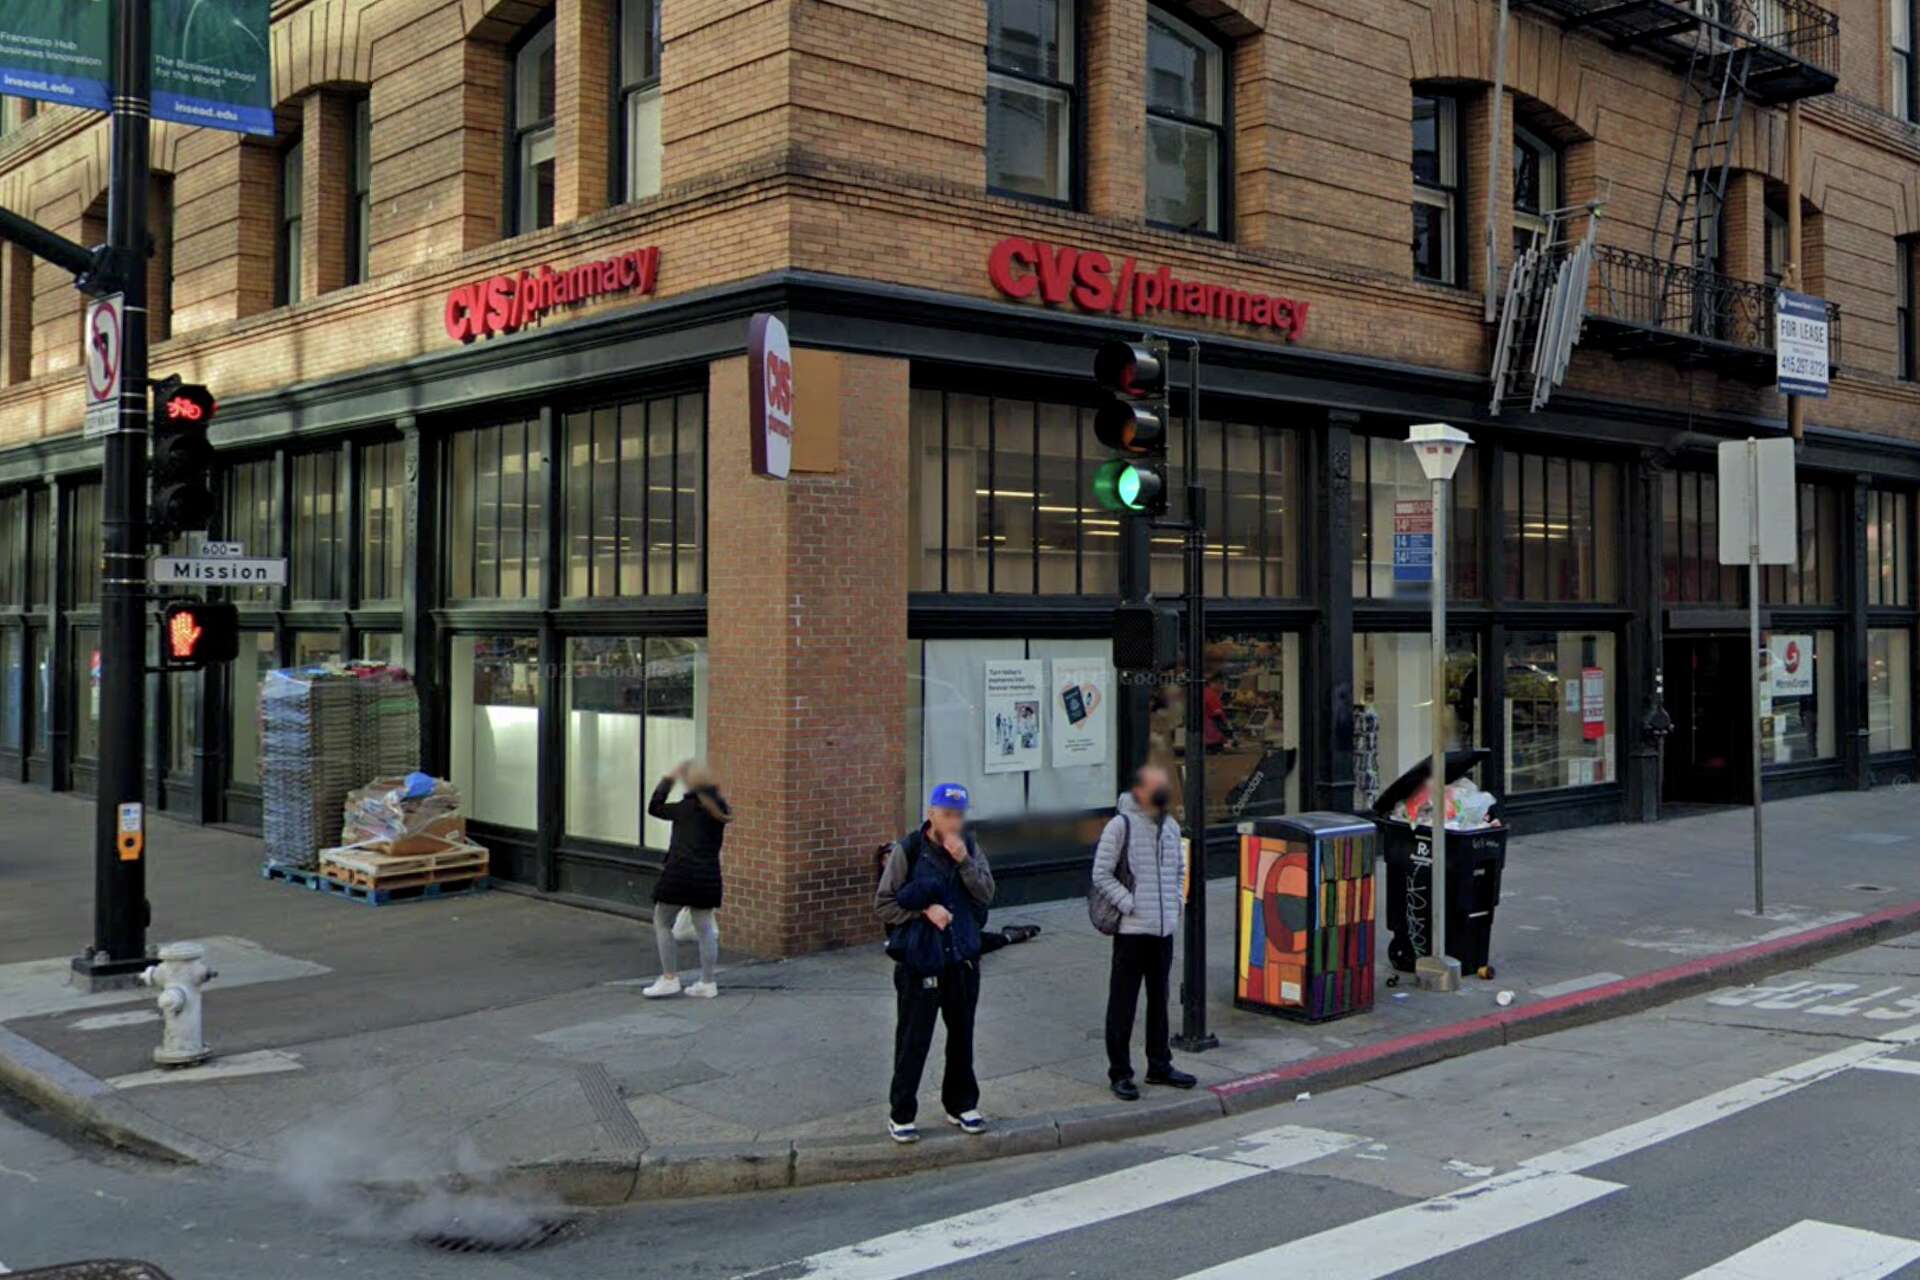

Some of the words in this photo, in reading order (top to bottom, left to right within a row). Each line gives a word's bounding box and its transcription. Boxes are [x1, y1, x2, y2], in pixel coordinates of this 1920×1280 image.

[54, 40, 77, 50] Hub
[45, 49, 102, 66] Innovation
[155, 54, 173, 66] The
[176, 59, 220, 75] Business
[223, 68, 256, 82] School
[155, 67, 169, 77] for
[172, 70, 189, 81] the
[4, 73, 74, 95] insead.edu
[174, 101, 238, 121] insead.edu
[1780, 319, 1797, 338] FOR
[1800, 323, 1825, 344] LEASE
[766, 351, 792, 416] CVS
[202, 544, 227, 555] 600
[174, 563, 267, 579] Mission
